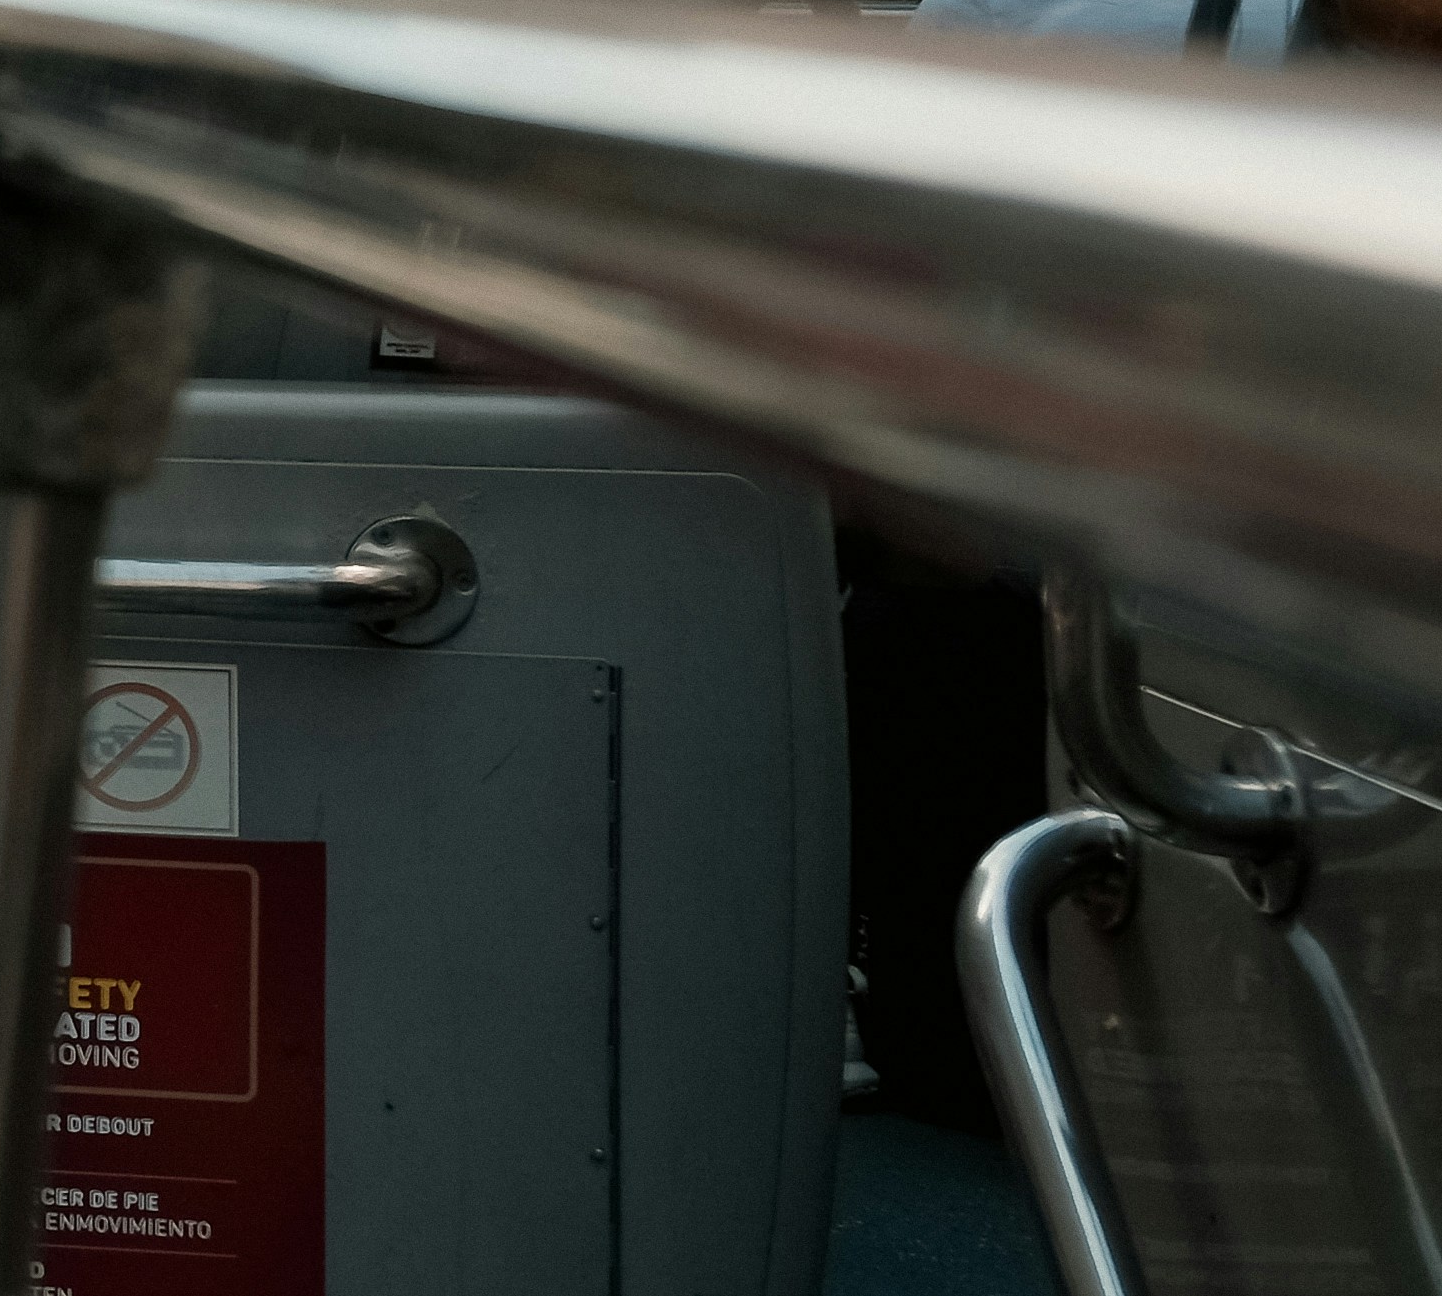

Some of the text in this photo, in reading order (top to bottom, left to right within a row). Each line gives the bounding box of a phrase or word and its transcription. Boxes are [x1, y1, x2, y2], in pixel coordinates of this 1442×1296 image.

[58, 975, 141, 1011] ETY
[50, 1042, 140, 1069] OVING
[66, 1114, 155, 1136] DEBOUT
[88, 1189, 119, 1209] DE
[123, 1191, 159, 1212] PIE
[44, 1212, 212, 1240] ENMOVIMIENTO
